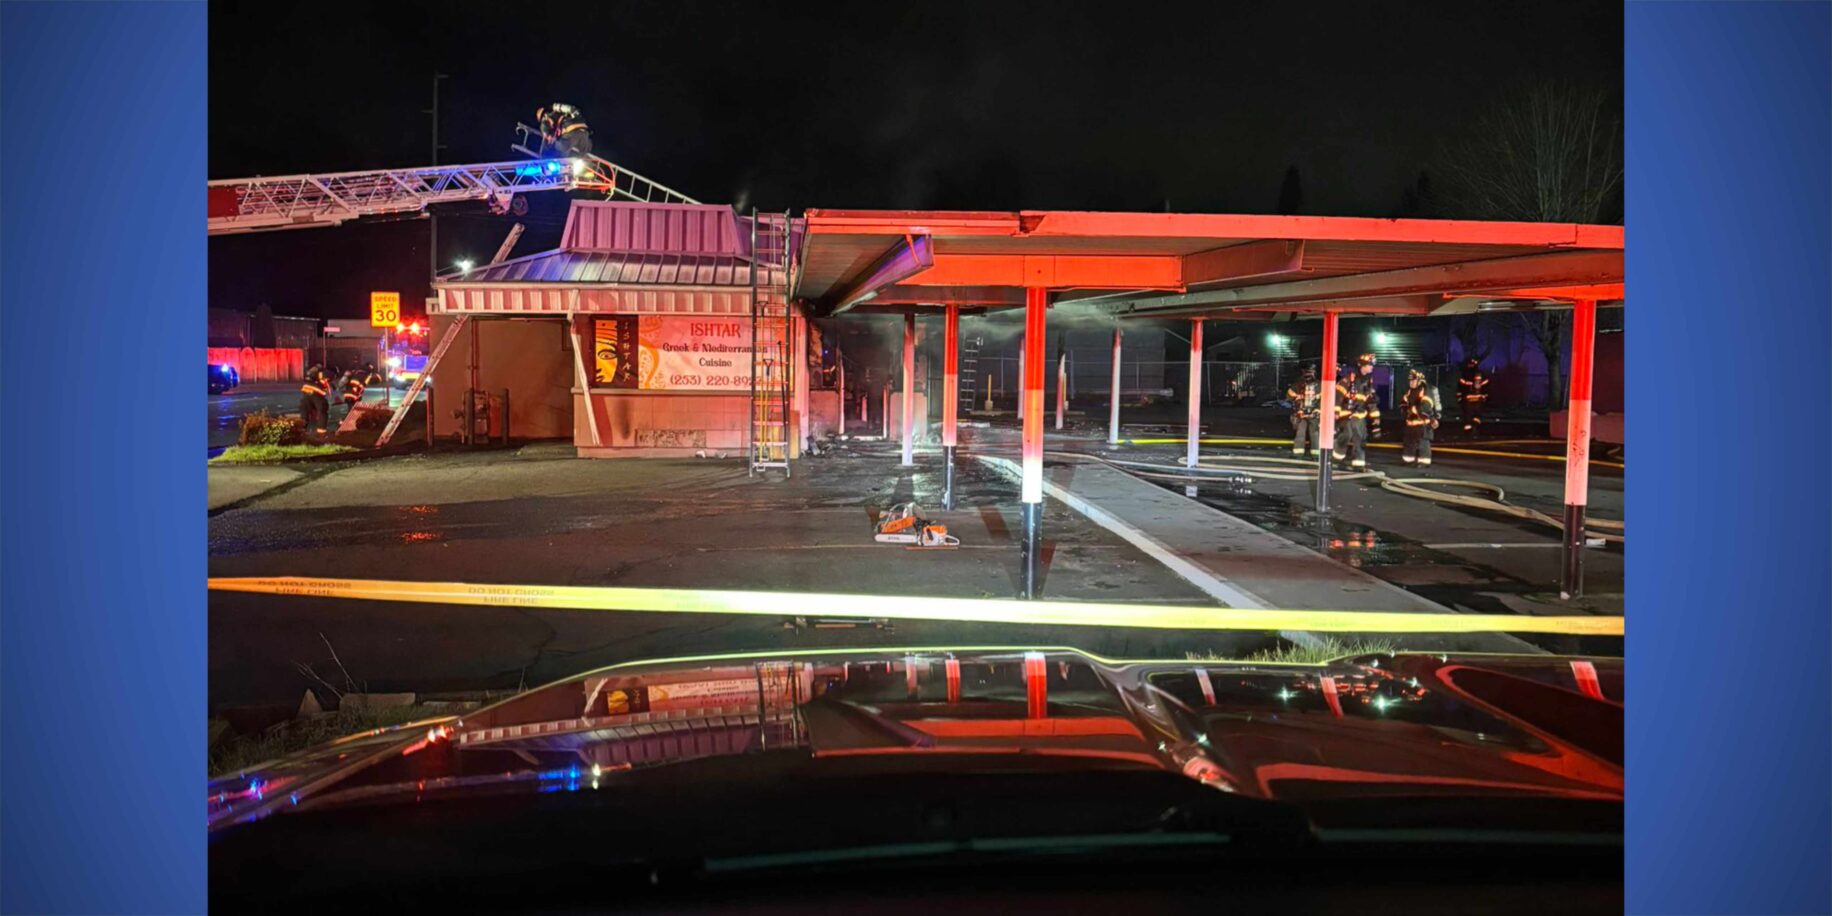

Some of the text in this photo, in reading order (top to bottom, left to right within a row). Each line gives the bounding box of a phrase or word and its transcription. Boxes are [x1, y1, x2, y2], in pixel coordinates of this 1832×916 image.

[376, 310, 396, 322] 30
[690, 322, 741, 338] ISHTAR
[623, 321, 631, 382] ISHTAR
[662, 342, 690, 353] Greek
[692, 343, 699, 353] &
[699, 357, 732, 367] Cuisine
[670, 374, 702, 386] (253)
